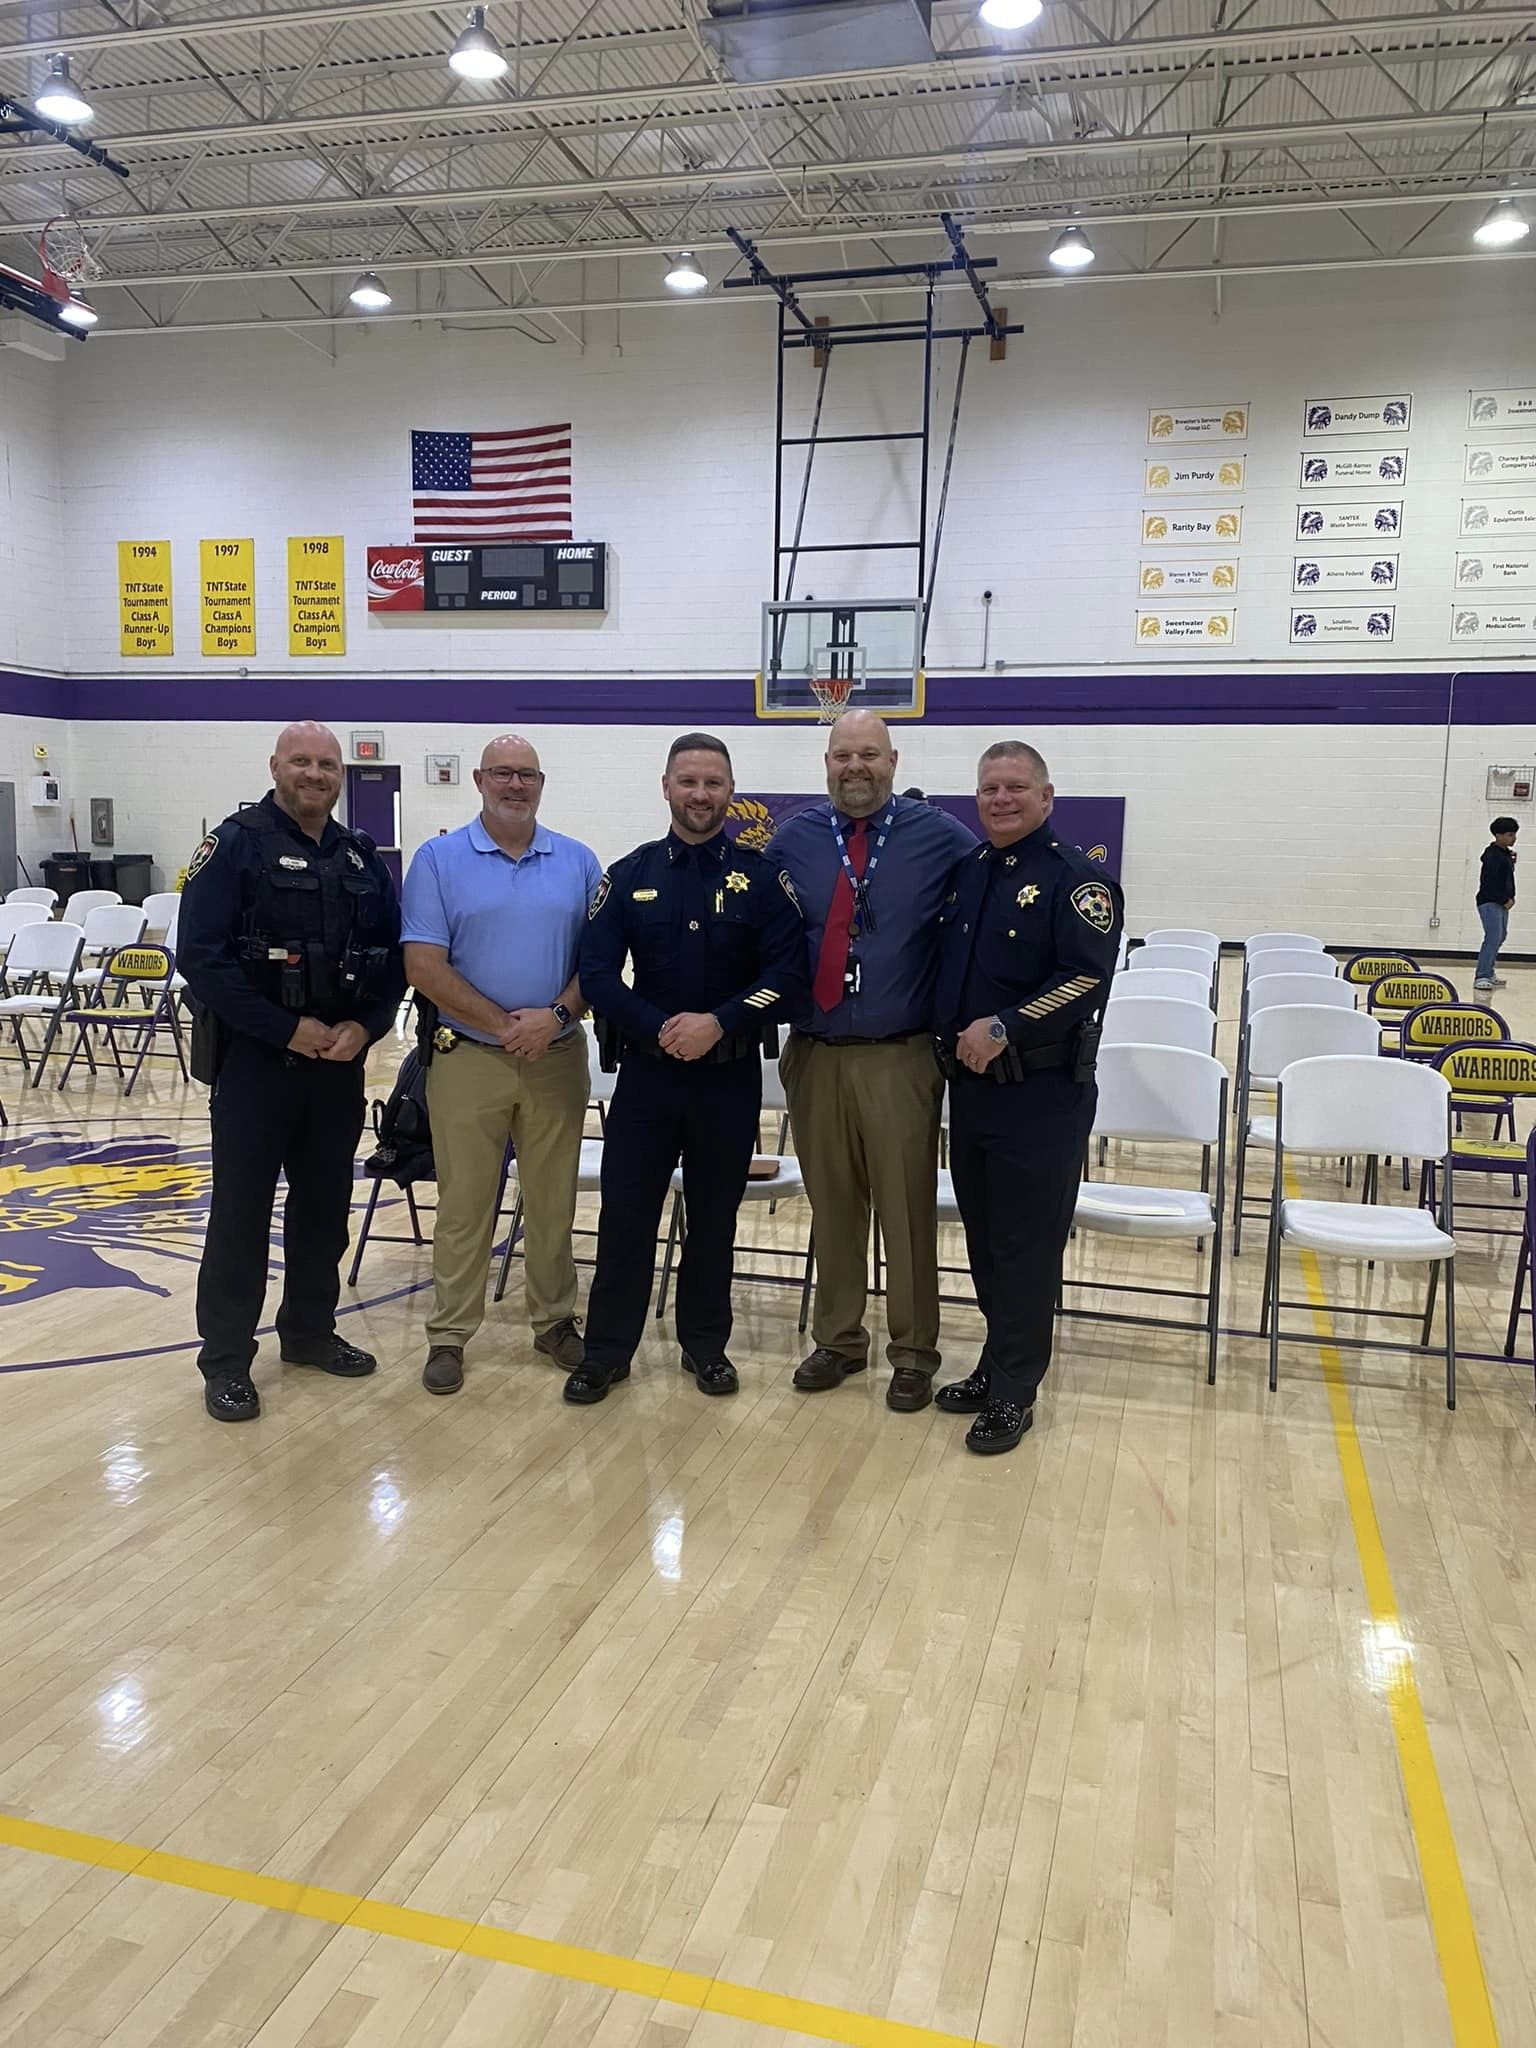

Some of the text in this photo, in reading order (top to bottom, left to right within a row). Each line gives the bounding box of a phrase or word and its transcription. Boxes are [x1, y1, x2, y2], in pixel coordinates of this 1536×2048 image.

[1192, 472, 1214, 480] Purdy
[1172, 523, 1211, 532] Rarity Bay
[133, 546, 157, 558] 1994
[214, 545, 239, 556] 1997
[303, 542, 329, 554] 1998
[557, 547, 595, 559] HOME
[431, 550, 472, 562] GUEST
[371, 559, 423, 579] Coca-Cola
[125, 583, 164, 592] TNT State
[207, 581, 247, 591] TNT State
[296, 580, 336, 590] TNT State
[204, 596, 251, 606] Tournament
[293, 595, 340, 605] Tournament
[481, 591, 517, 600] PERIOD
[124, 598, 168, 607] Tournament
[131, 611, 159, 621] Class A
[213, 611, 242, 620] Class A
[298, 610, 335, 620] Class AA
[205, 624, 251, 636] Champions
[293, 623, 340, 635] Champions
[136, 637, 156, 649] Boys
[217, 638, 238, 649] Boys
[306, 637, 326, 649] Boys
[118, 953, 164, 970] WARRIORS
[1357, 962, 1409, 976] WARRIORS
[1384, 983, 1444, 1000] WARRIORS
[1420, 1016, 1493, 1036] WARRIORS
